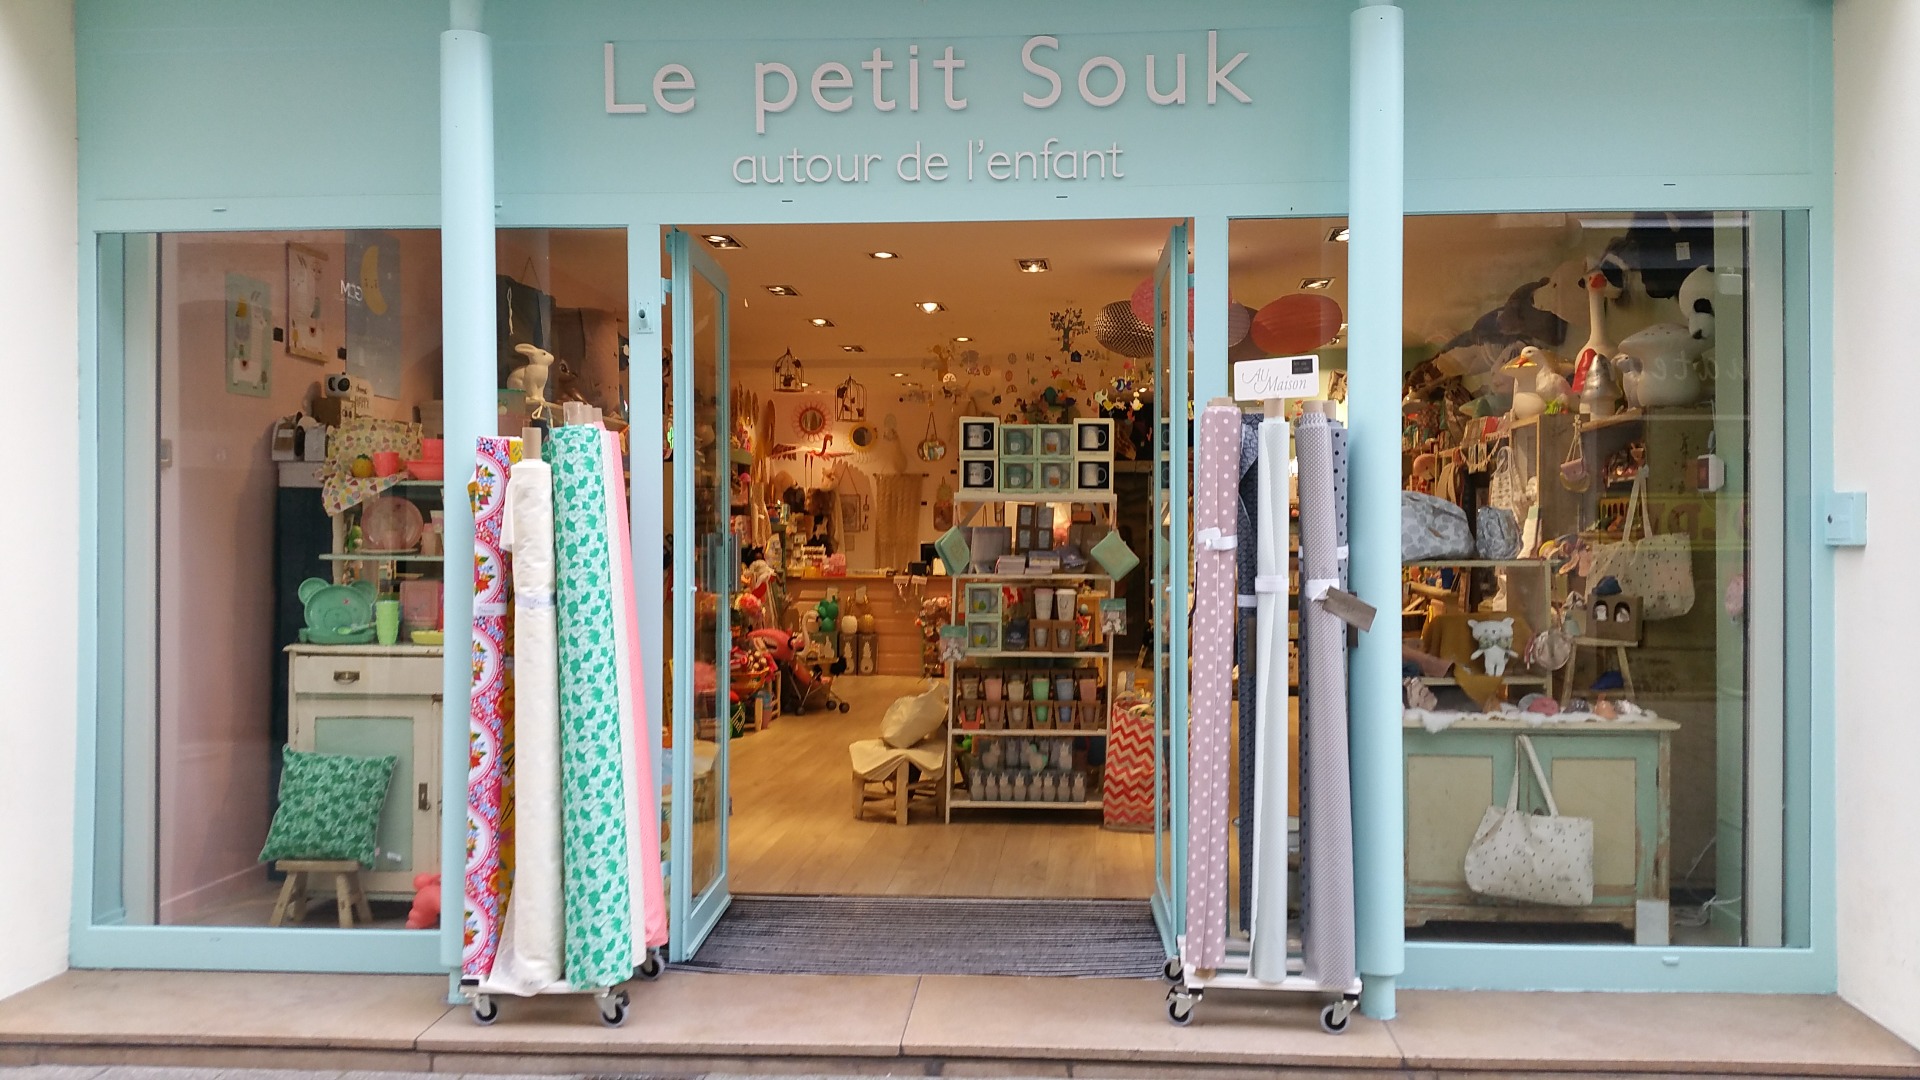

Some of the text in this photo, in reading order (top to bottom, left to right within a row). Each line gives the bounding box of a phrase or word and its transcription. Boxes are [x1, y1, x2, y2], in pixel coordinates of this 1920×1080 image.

[604, 29, 1253, 134] Le petit Souk
[732, 137, 1125, 185] autour de l'enfant
[1253, 375, 1307, 395] Maison
